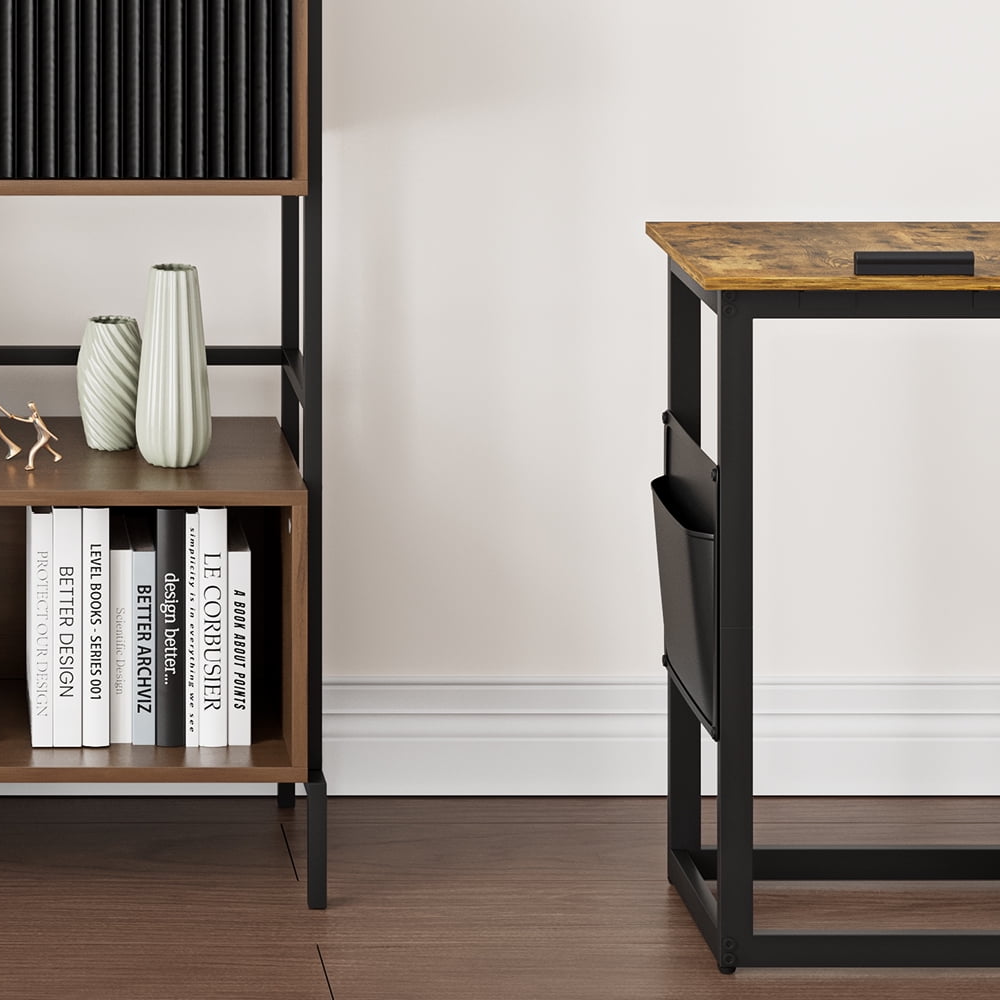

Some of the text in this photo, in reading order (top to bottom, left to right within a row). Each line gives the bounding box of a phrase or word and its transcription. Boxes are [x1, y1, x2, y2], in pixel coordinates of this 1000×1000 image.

[90, 544, 101, 579] LEVEL
[90, 584, 101, 625] BOOKS
[189, 592, 195, 602] is
[189, 607, 195, 618] in
[234, 601, 245, 629] BOOK
[37, 552, 48, 716] PROTECT OUR DESIGN
[59, 567, 74, 697] BETTER DESIGN
[160, 572, 179, 684] design better...
[204, 554, 221, 710] LE CORBUSIER
[90, 636, 101, 675] SERIES
[114, 607, 126, 695] Scientific Design
[137, 585, 151, 713] BETTER ARCHVIZ
[234, 633, 245, 668] ABOUT
[90, 679, 101, 699] 001
[189, 692, 195, 708] we
[234, 672, 245, 710] POINTS
